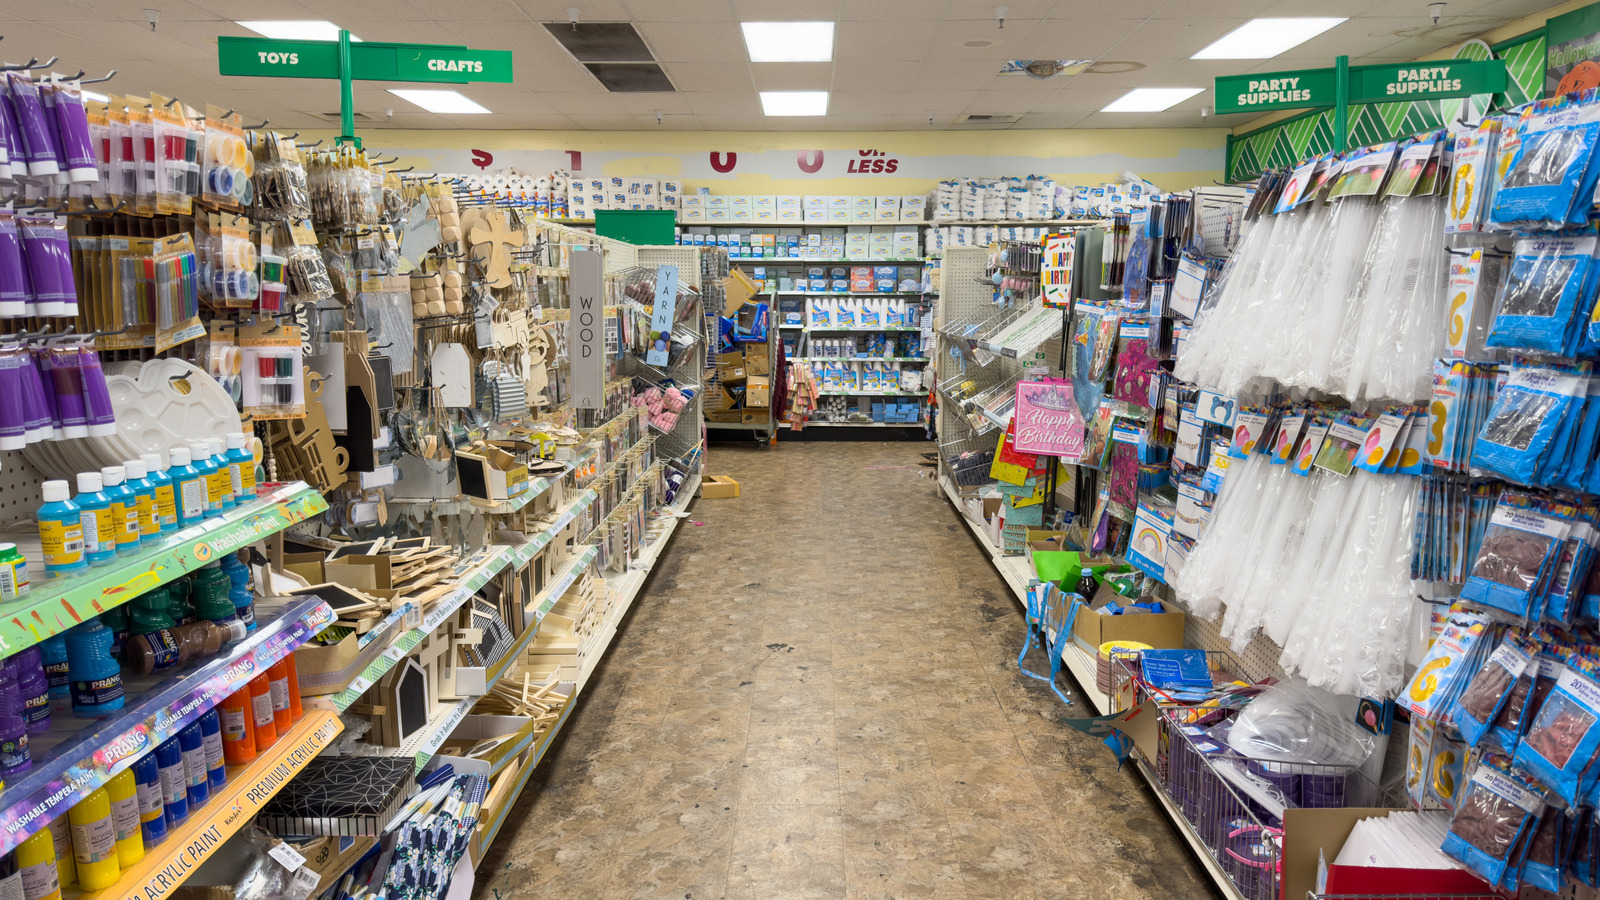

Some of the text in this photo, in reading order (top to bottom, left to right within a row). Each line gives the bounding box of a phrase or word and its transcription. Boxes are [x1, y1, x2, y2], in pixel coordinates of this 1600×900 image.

[258, 52, 299, 64] TOYS
[1547, 41, 1600, 70] Hallowee
[428, 59, 483, 72] CRAFTS
[1398, 67, 1450, 82] PARTY
[1249, 78, 1300, 92] PARTY
[1386, 79, 1461, 95] SUPPLIES
[1237, 89, 1311, 106] SUPPLIES
[847, 159, 898, 173] LESS
[659, 271, 672, 325] YARN
[580, 297, 593, 358] WOOD
[1026, 409, 1075, 432] Happy
[1018, 427, 1082, 451] Birthday
[208, 525, 258, 553] Washable
[253, 515, 280, 532] Paint
[426, 615, 438, 627] Grab
[160, 629, 178, 652] PRANG
[46, 662, 69, 673] PRA
[154, 710, 182, 733] WASHABLE
[181, 696, 204, 716] TEMPERA
[202, 687, 218, 701] PAINT
[222, 659, 253, 684] PRANG
[307, 606, 332, 626] PRANG
[91, 674, 121, 689] PRANG
[1570, 678, 1582, 690] 20
[25, 692, 48, 708] PRAN
[246, 718, 339, 806] PREMIUM ACRYLIC PAINT
[6, 730, 146, 834] WASHABLE TEMPERA PAINT PRANG
[1484, 773, 1494, 781] 20
[143, 852, 193, 900] ACRYLIC
[187, 824, 223, 862] PAINT
